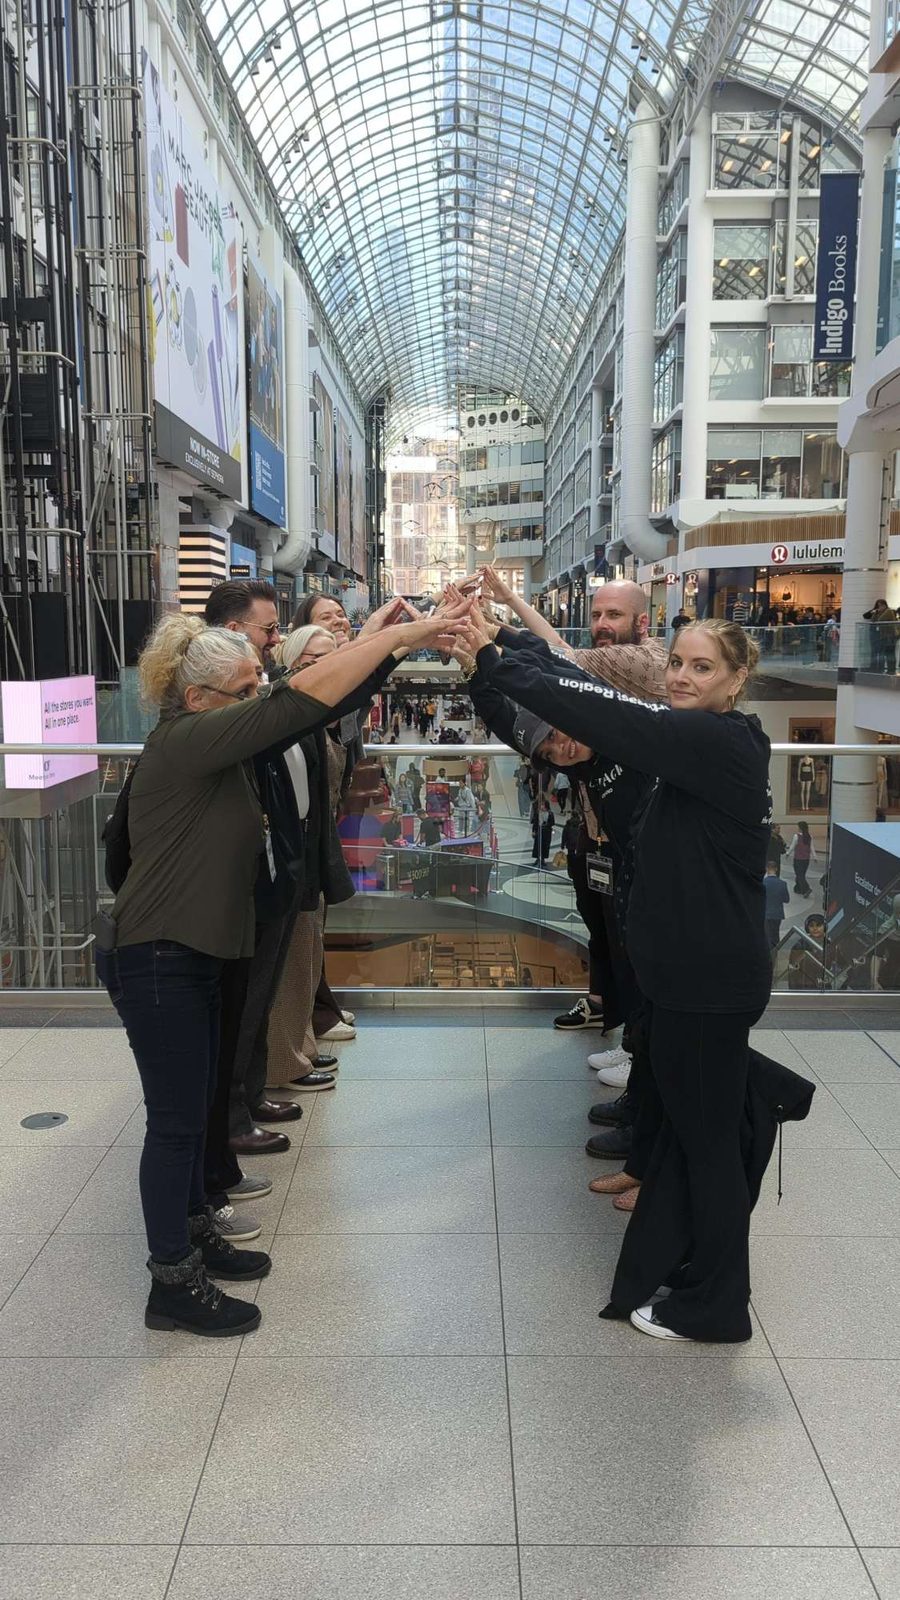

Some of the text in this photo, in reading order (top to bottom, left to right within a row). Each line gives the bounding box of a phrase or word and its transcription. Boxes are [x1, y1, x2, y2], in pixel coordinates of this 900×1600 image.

[168, 130, 192, 188] MARC
[184, 184, 213, 242] BEAUTY
[828, 235, 847, 292] Books
[793, 543, 845, 560] lululem
[558, 678, 615, 700] Region
[51, 701, 59, 713] the
[59, 700, 74, 711] stores
[74, 699, 83, 711] you
[52, 716, 57, 728] in
[57, 717, 66, 727] one
